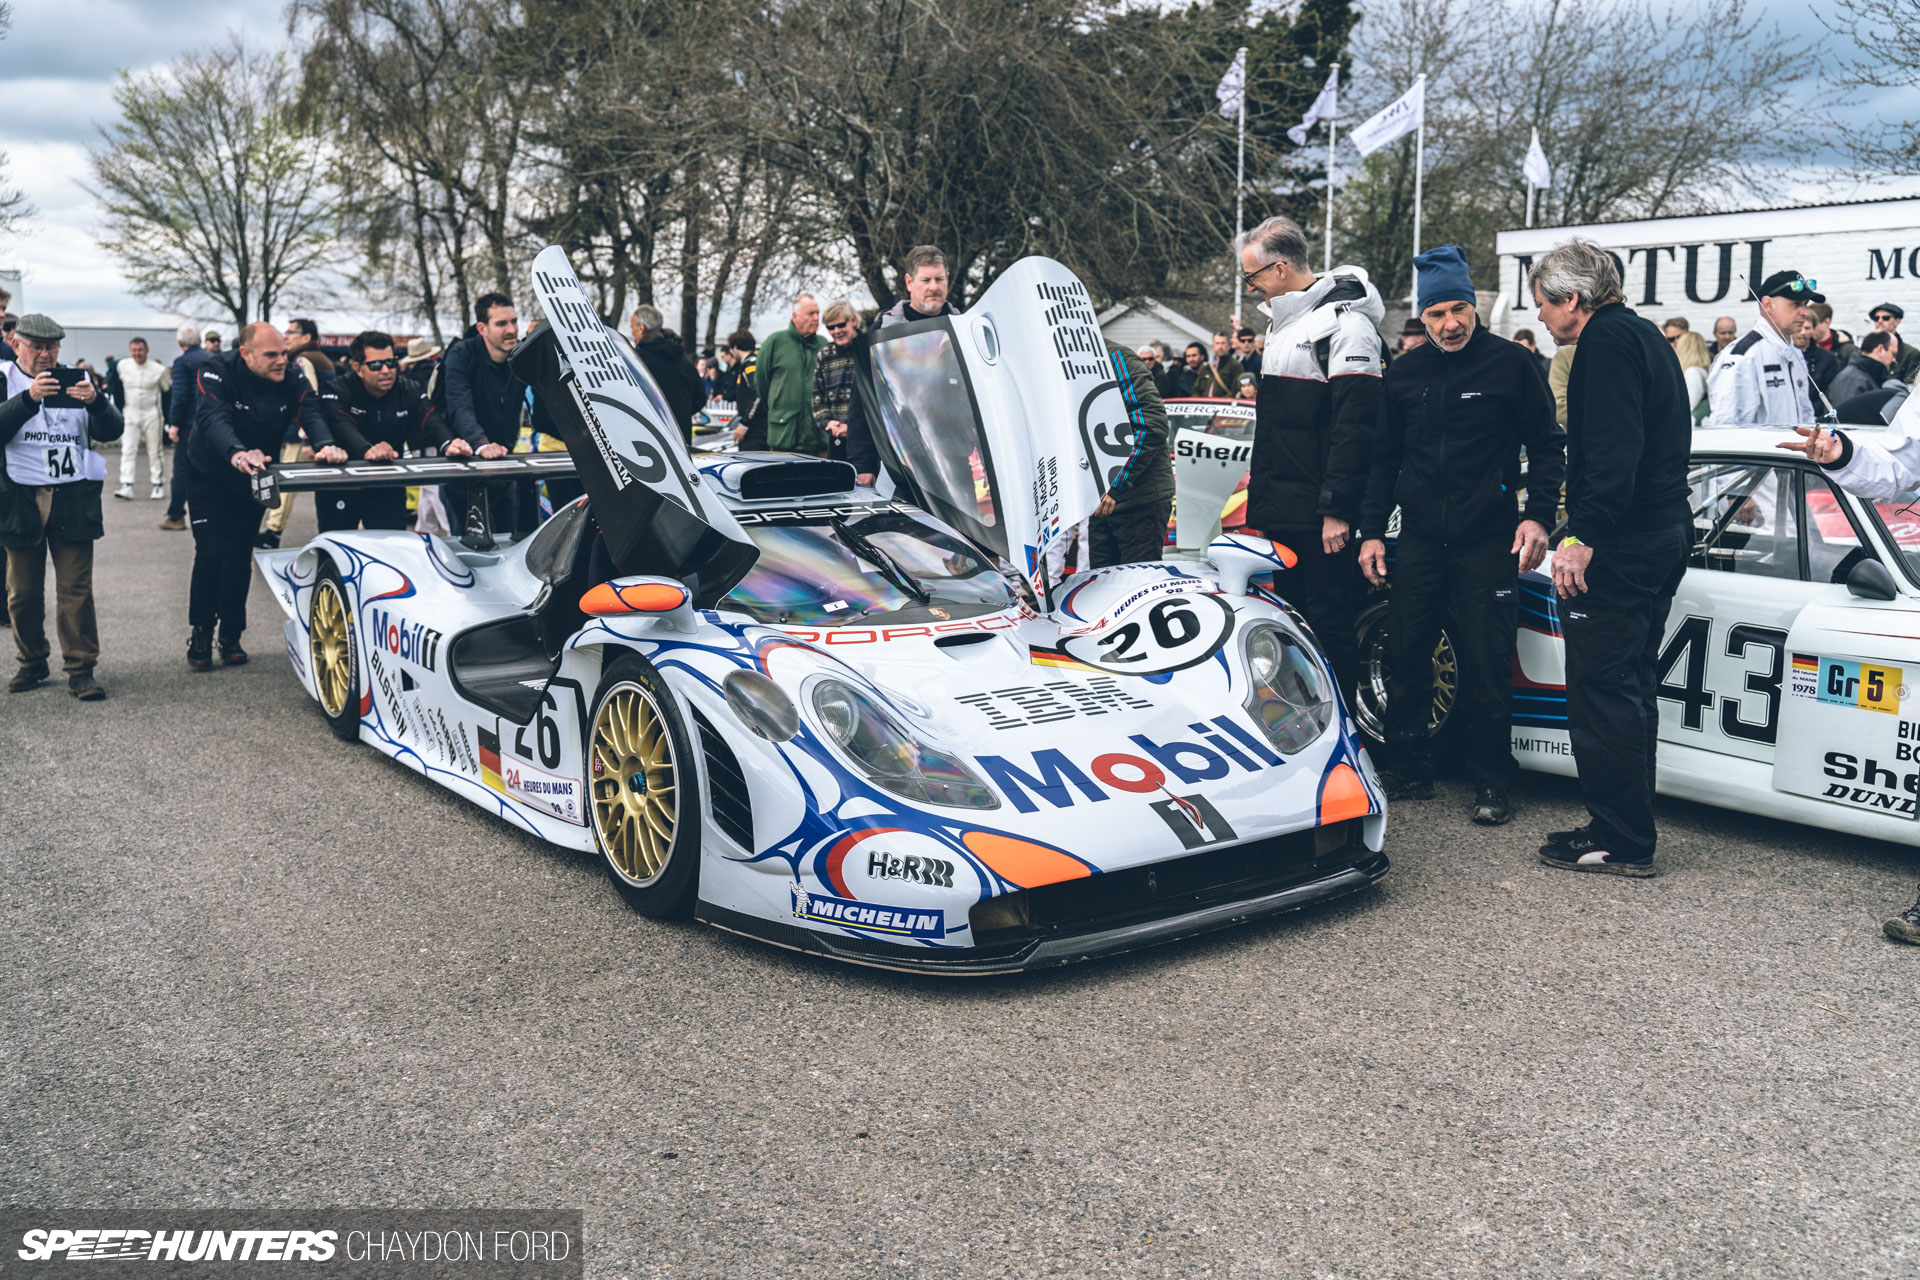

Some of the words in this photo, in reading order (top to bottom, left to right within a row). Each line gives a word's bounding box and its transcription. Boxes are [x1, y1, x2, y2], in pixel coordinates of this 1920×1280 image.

[1512, 239, 1773, 310] TUL
[536, 272, 638, 388] IBM
[1037, 282, 1111, 380] IBM
[583, 409, 609, 461] SOLUTIONS
[1177, 440, 1250, 462] Shell
[48, 446, 76, 478] 54
[279, 457, 575, 479] PORSC
[1037, 456, 1048, 507] McNish
[1047, 456, 1058, 497] Ortelli
[735, 504, 919, 524] ORSCHE
[783, 604, 1038, 645] PORSCHE
[1070, 616, 1109, 635] 24
[1114, 588, 1150, 619] HEURES
[1151, 582, 1168, 591] DU
[1169, 579, 1203, 587] MANS
[373, 607, 425, 665] Mobil
[1097, 598, 1201, 664] 26
[371, 649, 408, 738] BILSTEIN
[954, 677, 1154, 730] IBM
[1657, 614, 1789, 747] 43
[1792, 683, 1816, 694] 1978
[1828, 664, 1860, 698] Gr
[1867, 670, 1884, 702] 5
[973, 714, 1287, 814] Mobil
[1511, 737, 1576, 757] HMITTHE
[506, 768, 521, 789] 24
[523, 780, 542, 793] HEURES
[543, 781, 551, 794] DU
[552, 783, 573, 795] MANS
[868, 850, 931, 885] H&R
[812, 900, 938, 930] MICHELIN
